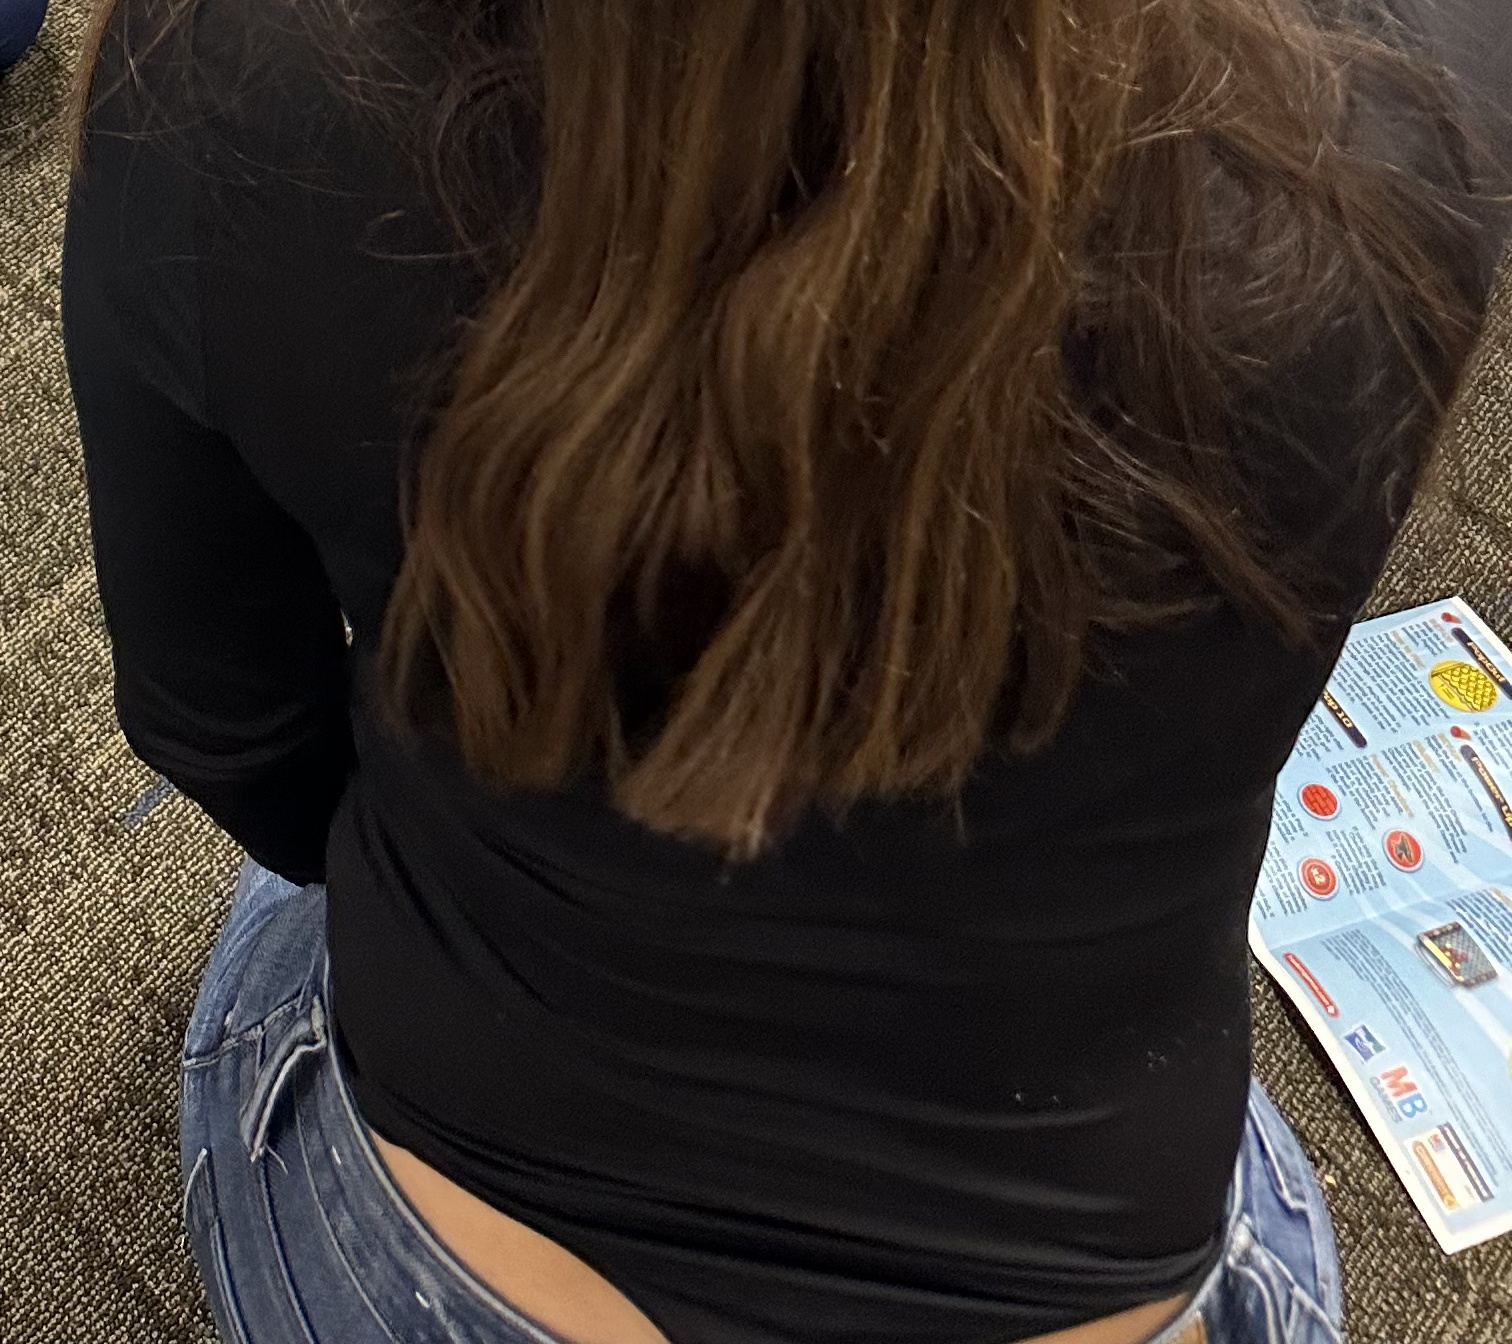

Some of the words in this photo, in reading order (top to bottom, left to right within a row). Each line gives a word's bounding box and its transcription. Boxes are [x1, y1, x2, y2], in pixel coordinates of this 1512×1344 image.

[1466, 640, 1505, 683] PopOut
[1335, 710, 1353, 728] 10
[1469, 754, 1505, 804] Power
[1368, 1073, 1402, 1125] GAMES
[1380, 1062, 1430, 1122] MB
